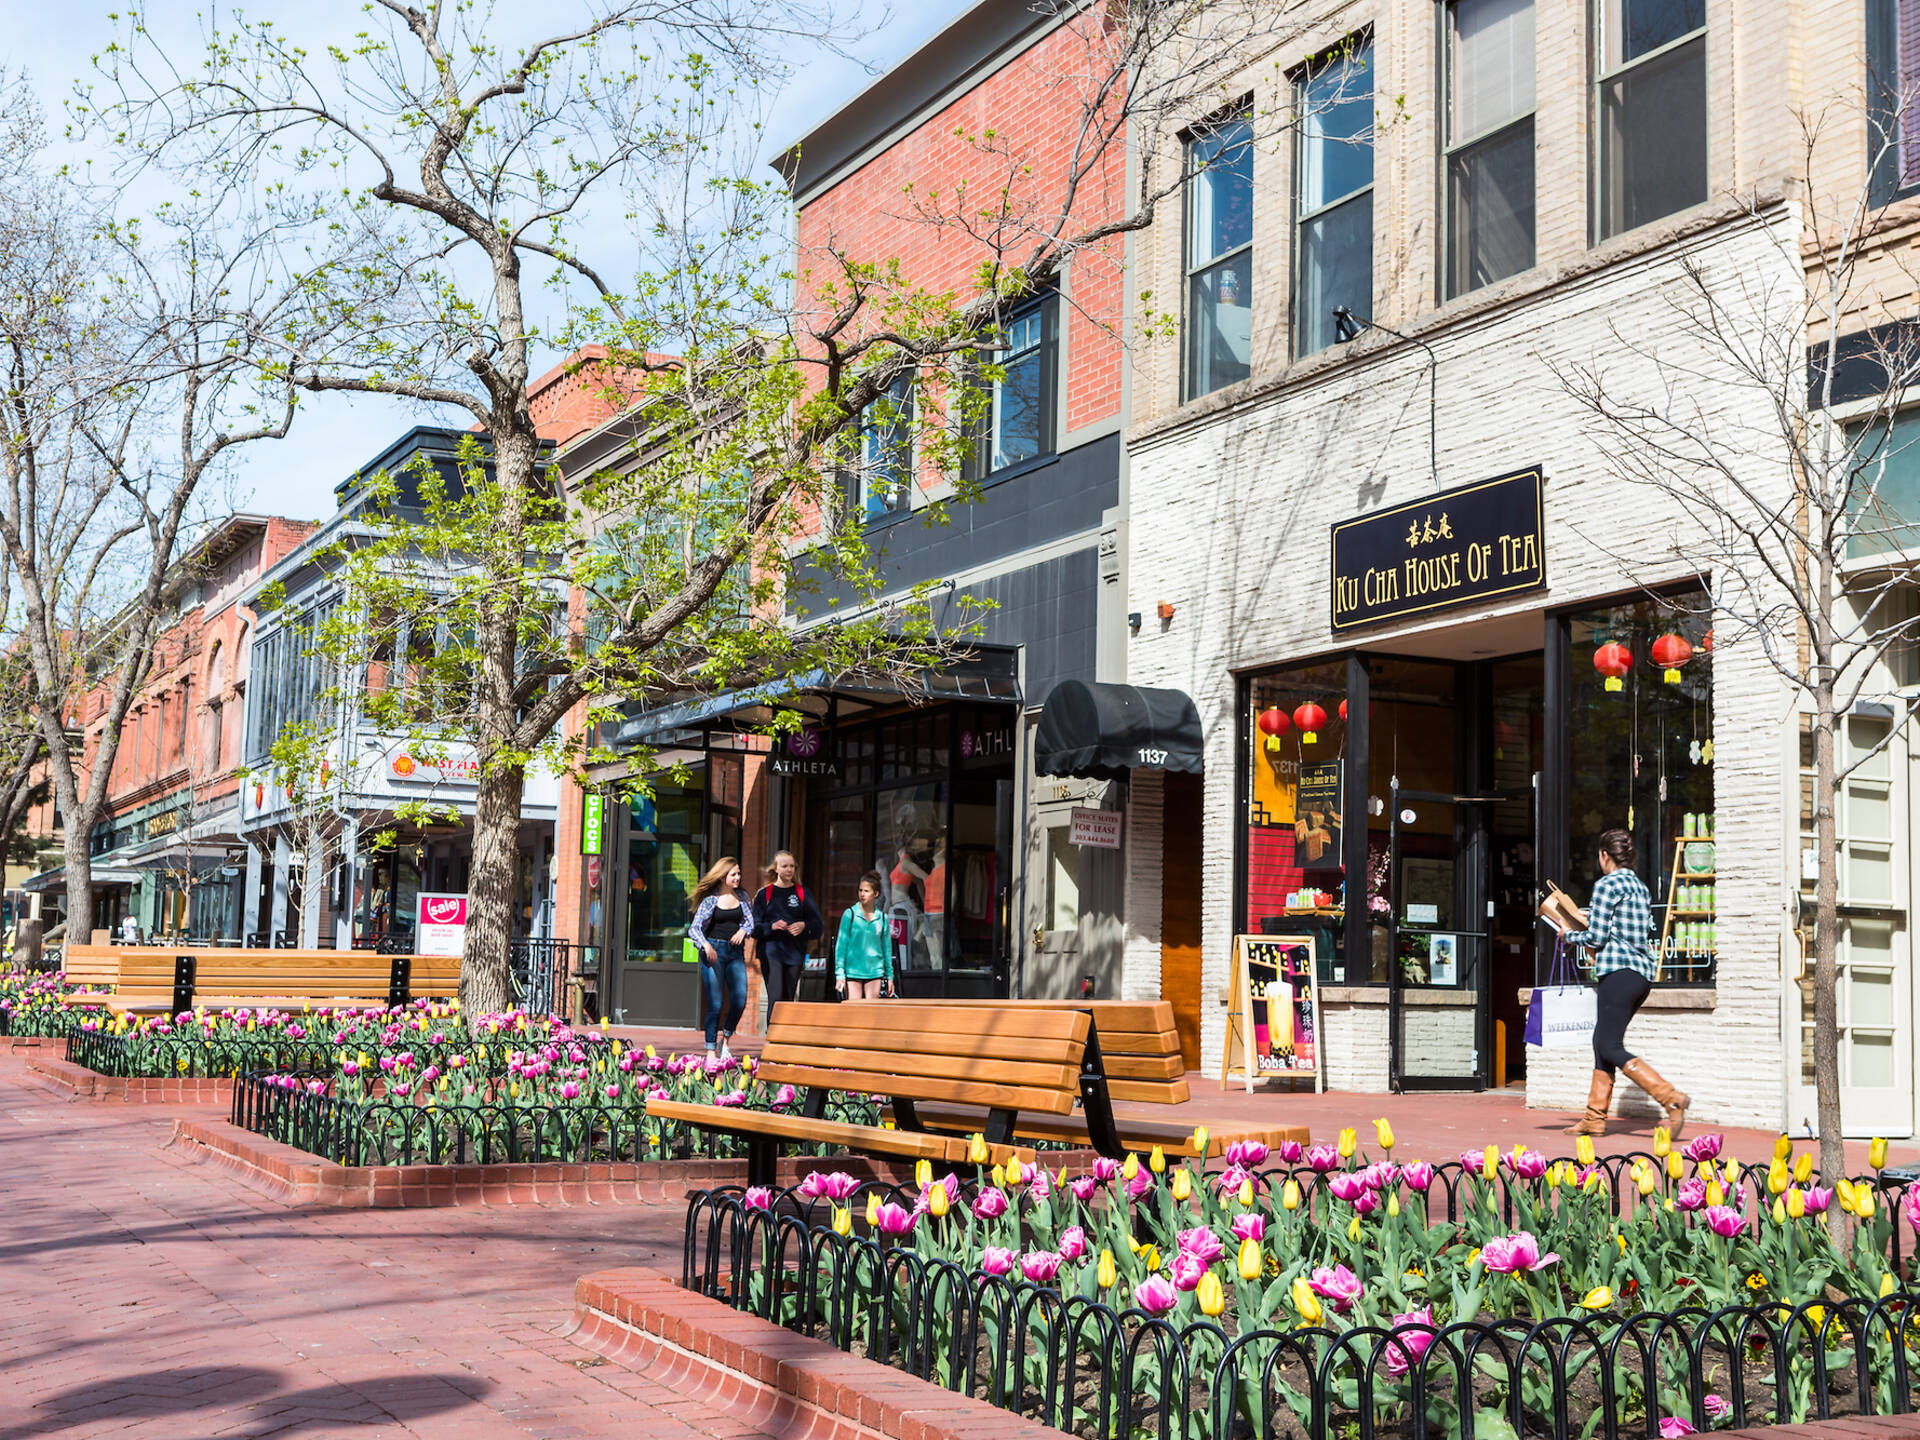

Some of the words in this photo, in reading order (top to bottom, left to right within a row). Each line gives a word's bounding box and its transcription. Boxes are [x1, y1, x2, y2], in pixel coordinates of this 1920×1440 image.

[1404, 552, 1461, 597] HOUSE
[1467, 543, 1492, 583] OF
[1498, 534, 1538, 576] TEA
[1138, 748, 1168, 764] 1137
[772, 759, 836, 774] ATHLETA
[587, 795, 599, 852] crocs
[1074, 812, 1096, 821] OFFICE
[1098, 815, 1118, 823] SUITES
[1075, 823, 1091, 832] FOR
[1094, 825, 1115, 834] LEASE
[430, 899, 457, 916] sale
[1302, 1000, 1314, 1057] 珍珠奶茶
[1547, 1021, 1594, 1033] WEEKENDS
[1258, 1054, 1287, 1069] Boba
[1288, 1054, 1314, 1069] Tea
